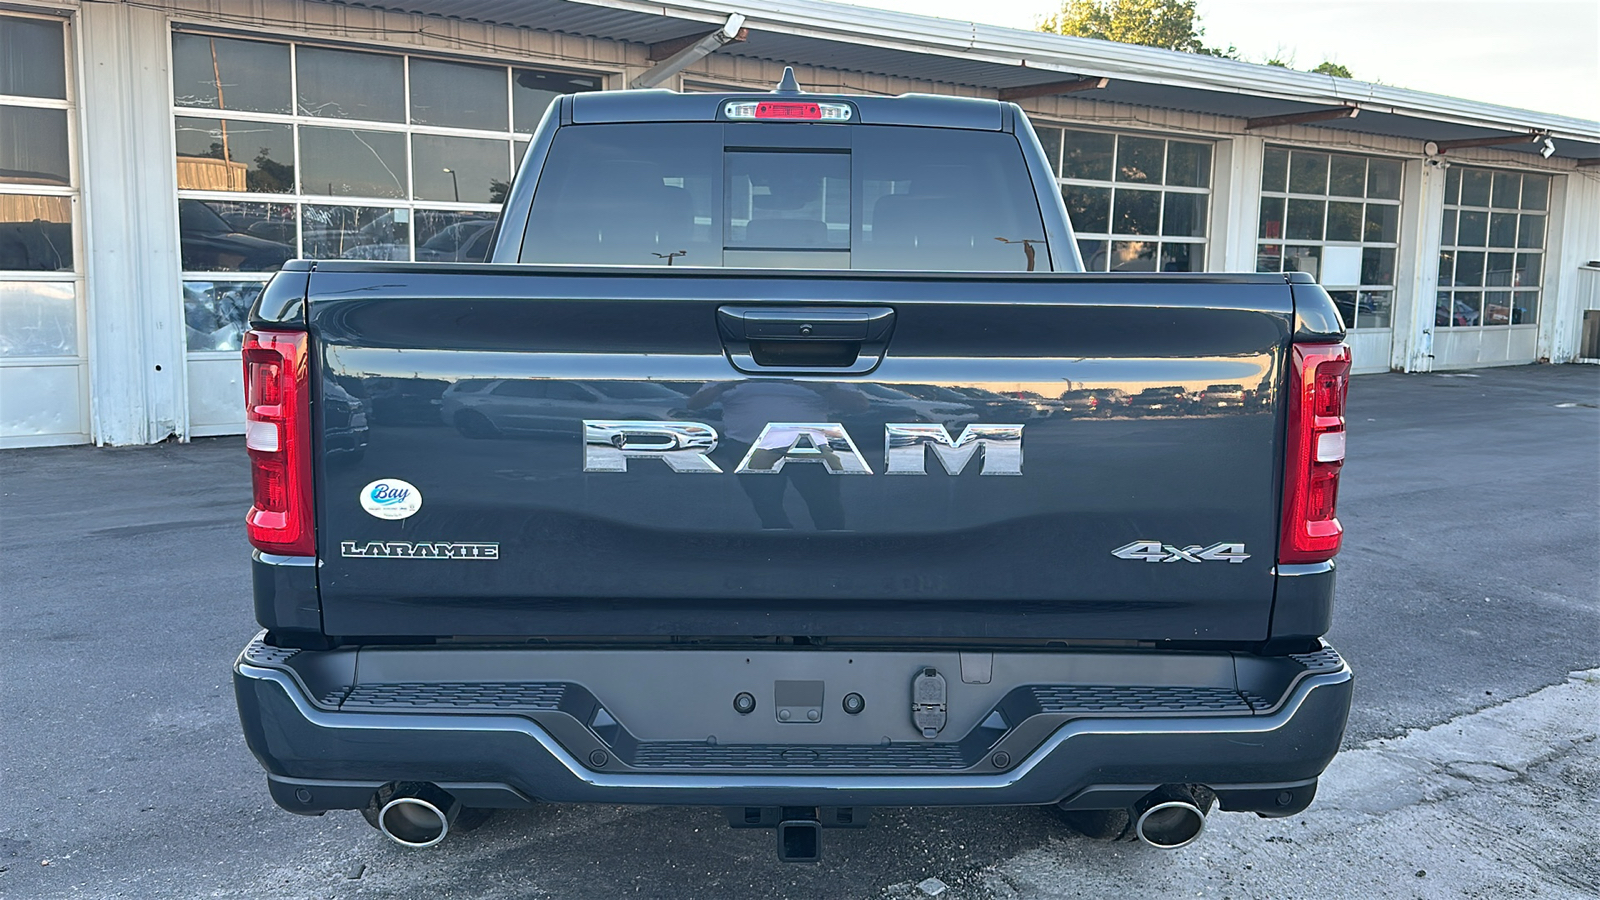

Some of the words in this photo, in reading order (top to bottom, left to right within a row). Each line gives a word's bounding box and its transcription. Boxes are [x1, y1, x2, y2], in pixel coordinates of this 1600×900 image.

[582, 419, 1026, 476] RAM
[374, 483, 411, 503] Bay
[340, 540, 500, 560] LARAMIE
[1110, 539, 1252, 563] 4x4
